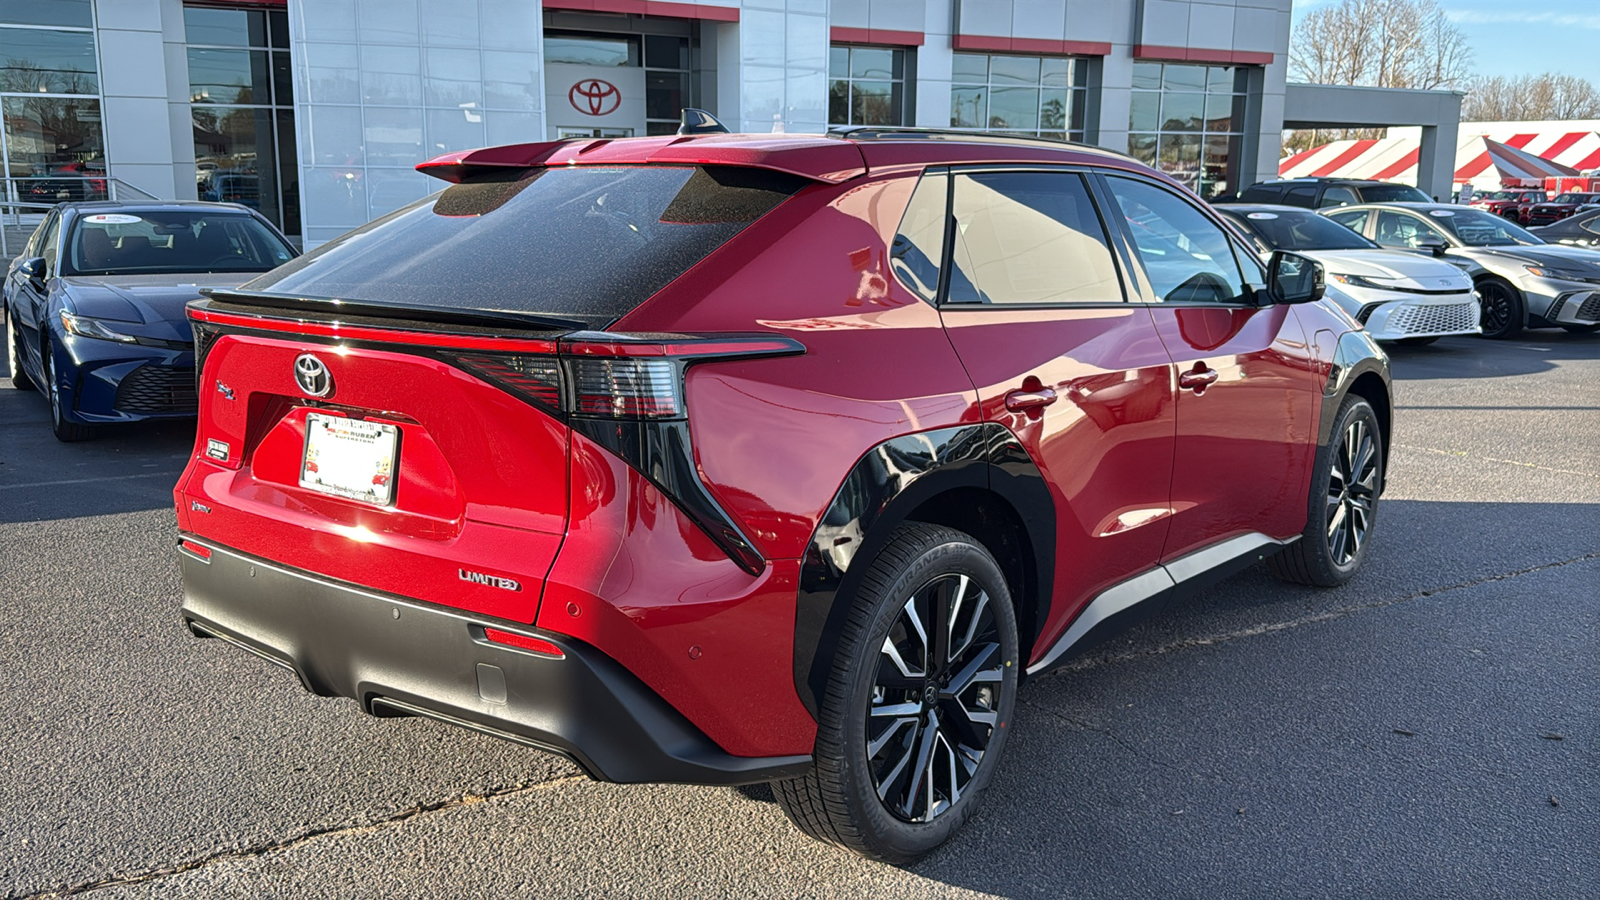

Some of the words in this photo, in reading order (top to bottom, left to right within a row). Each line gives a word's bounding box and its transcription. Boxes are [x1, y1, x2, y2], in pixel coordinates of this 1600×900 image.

[350, 431, 376, 440] RUBEN
[458, 568, 520, 591] LIMITED
[889, 547, 948, 603] TURANZA
